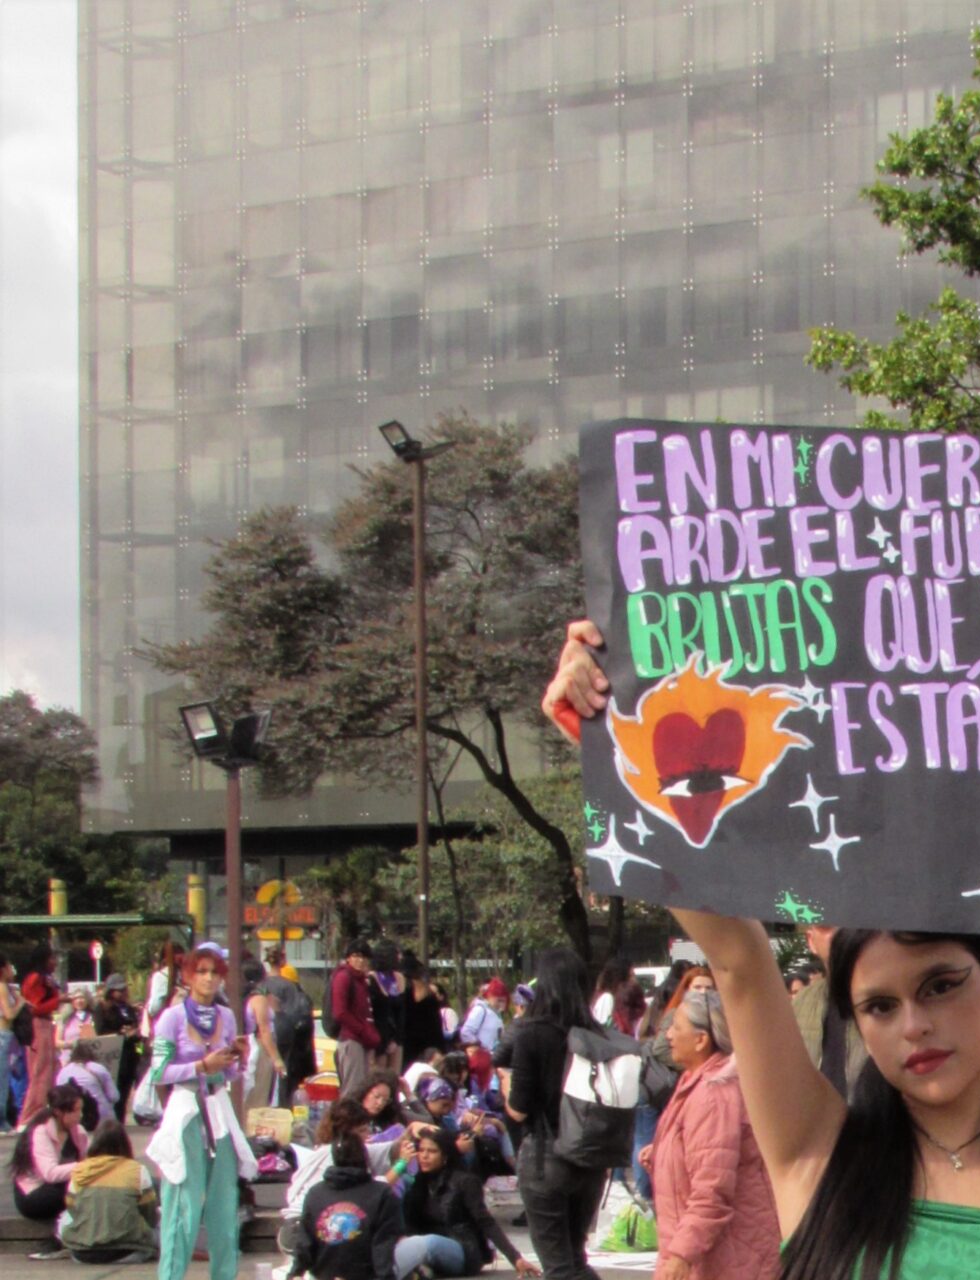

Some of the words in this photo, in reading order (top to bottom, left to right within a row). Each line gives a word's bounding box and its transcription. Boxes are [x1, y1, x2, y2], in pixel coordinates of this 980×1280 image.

[614, 430, 716, 513] EN
[731, 430, 797, 510] MI
[616, 510, 775, 592] ARDE
[790, 506, 879, 581] EL
[626, 576, 838, 679] BRUJAS
[864, 575, 971, 674] QUE
